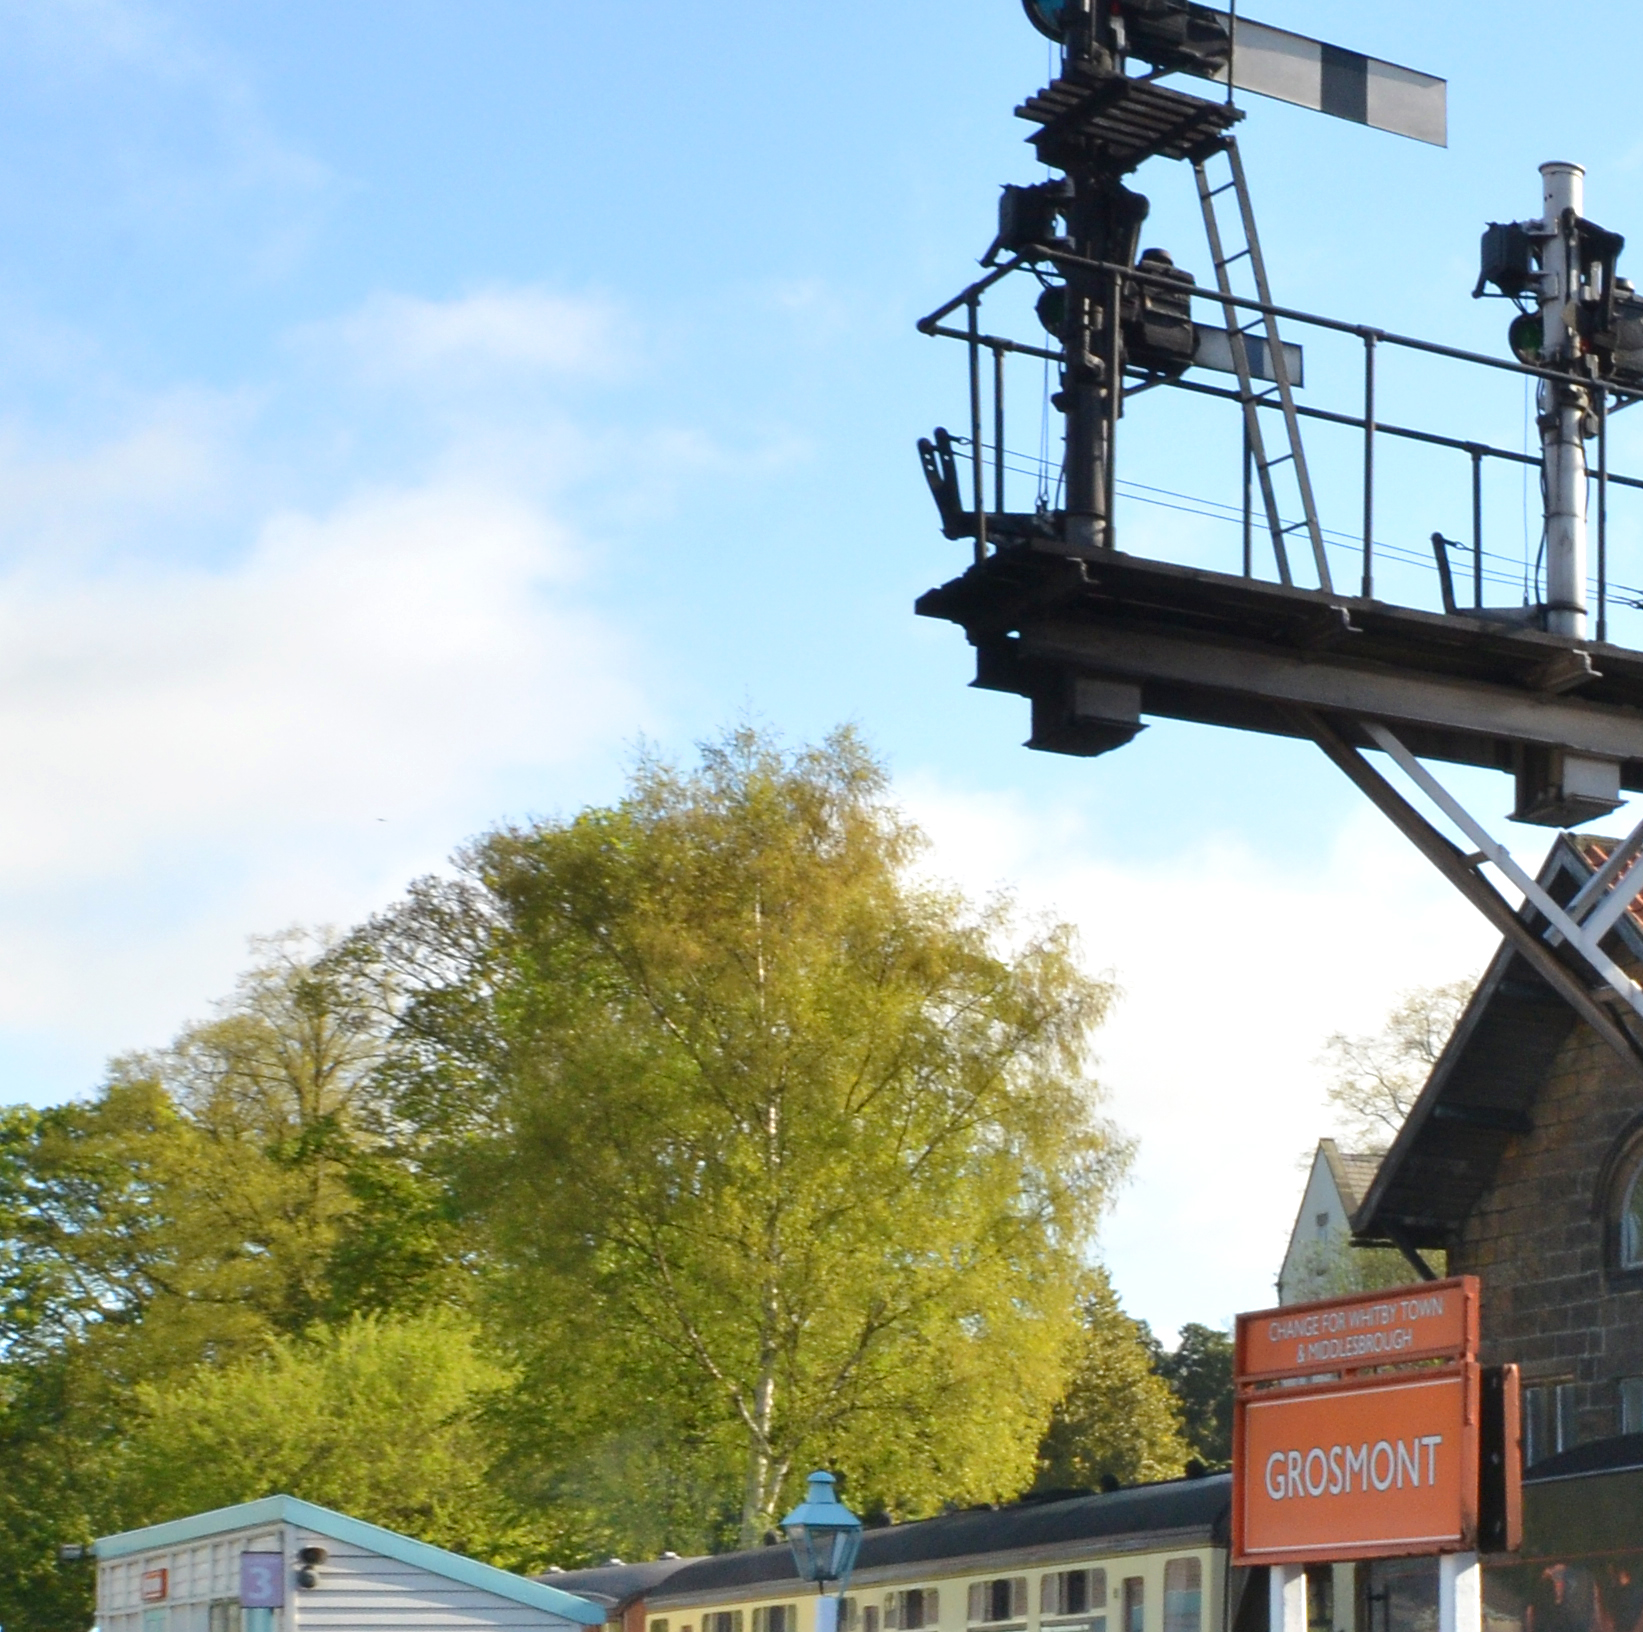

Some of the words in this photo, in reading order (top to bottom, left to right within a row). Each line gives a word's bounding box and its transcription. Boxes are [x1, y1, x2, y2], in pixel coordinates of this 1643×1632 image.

[1269, 1316, 1319, 1342] CHANGE
[1322, 1312, 1345, 1333] FOR
[1349, 1303, 1398, 1328] WHITBY
[1401, 1296, 1445, 1321] TOWN
[1296, 1344, 1306, 1363] &
[1308, 1328, 1413, 1361] MIDDLESBROUGH
[1264, 1434, 1443, 1501] GROSMONT
[248, 1566, 273, 1599] 3
